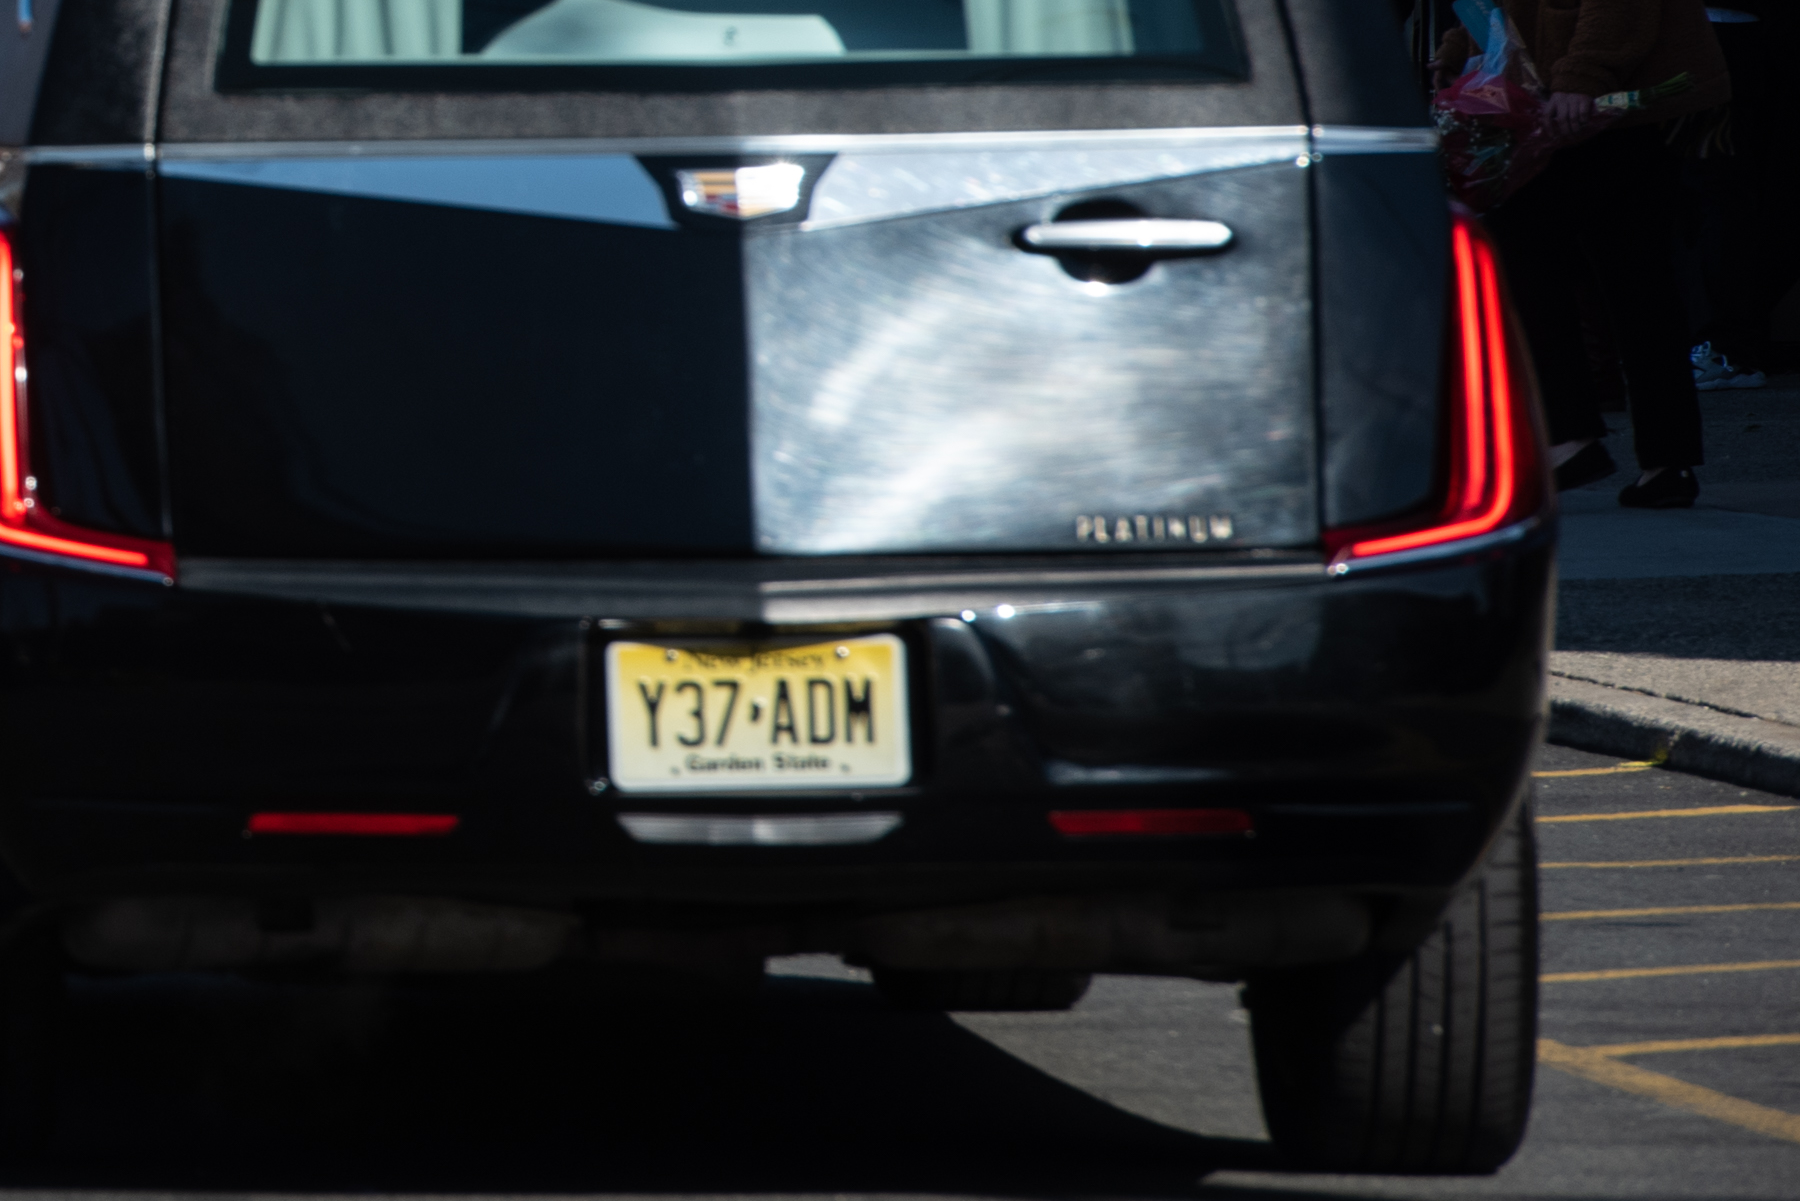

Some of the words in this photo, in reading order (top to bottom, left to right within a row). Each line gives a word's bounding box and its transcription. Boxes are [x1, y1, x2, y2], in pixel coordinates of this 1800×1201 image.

[1075, 514, 1234, 544] PLATINUM
[686, 753, 763, 771] Garden
[773, 752, 831, 769] State
